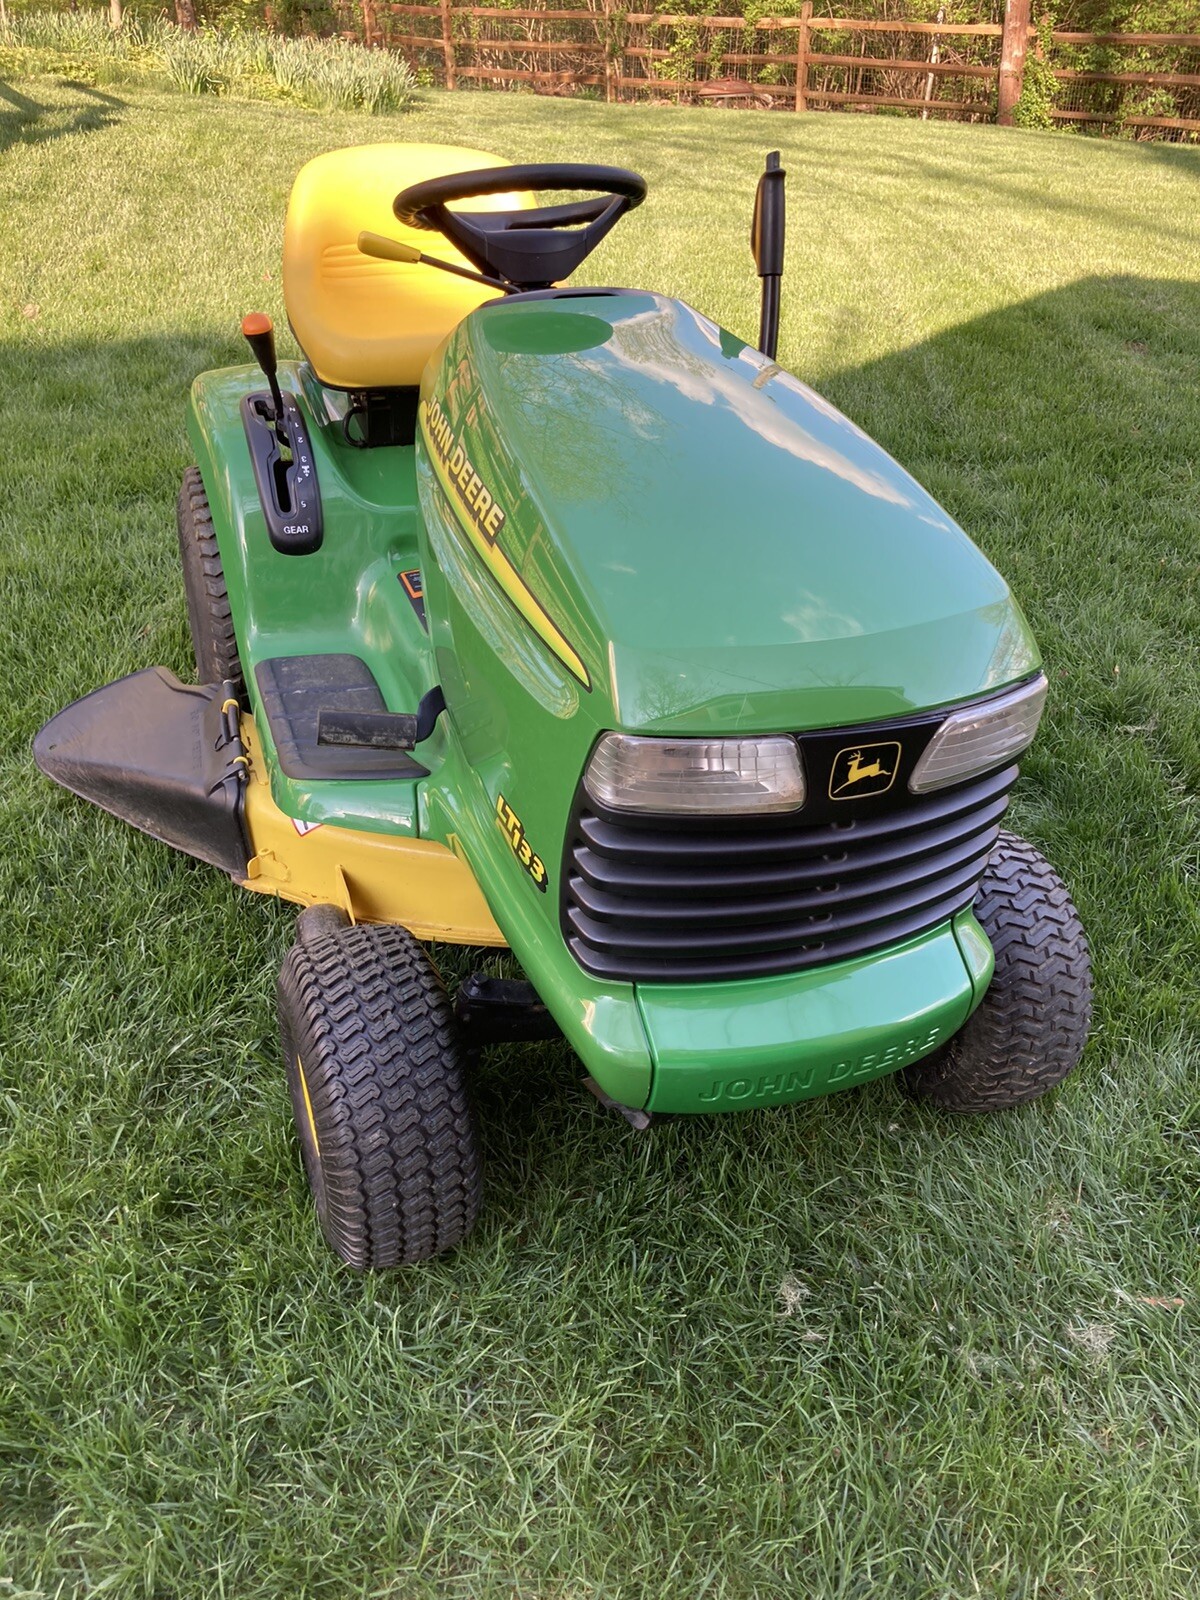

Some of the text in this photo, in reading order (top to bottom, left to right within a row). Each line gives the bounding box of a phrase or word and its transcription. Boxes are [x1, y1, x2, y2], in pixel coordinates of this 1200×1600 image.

[297, 436, 304, 444] 2
[426, 397, 505, 538] JOHN DEERE
[297, 476, 303, 484] 4
[300, 500, 307, 508] 5
[283, 525, 309, 535] GEAR
[496, 794, 546, 885] LT133
[698, 1027, 940, 1103] JOHN DEERE
